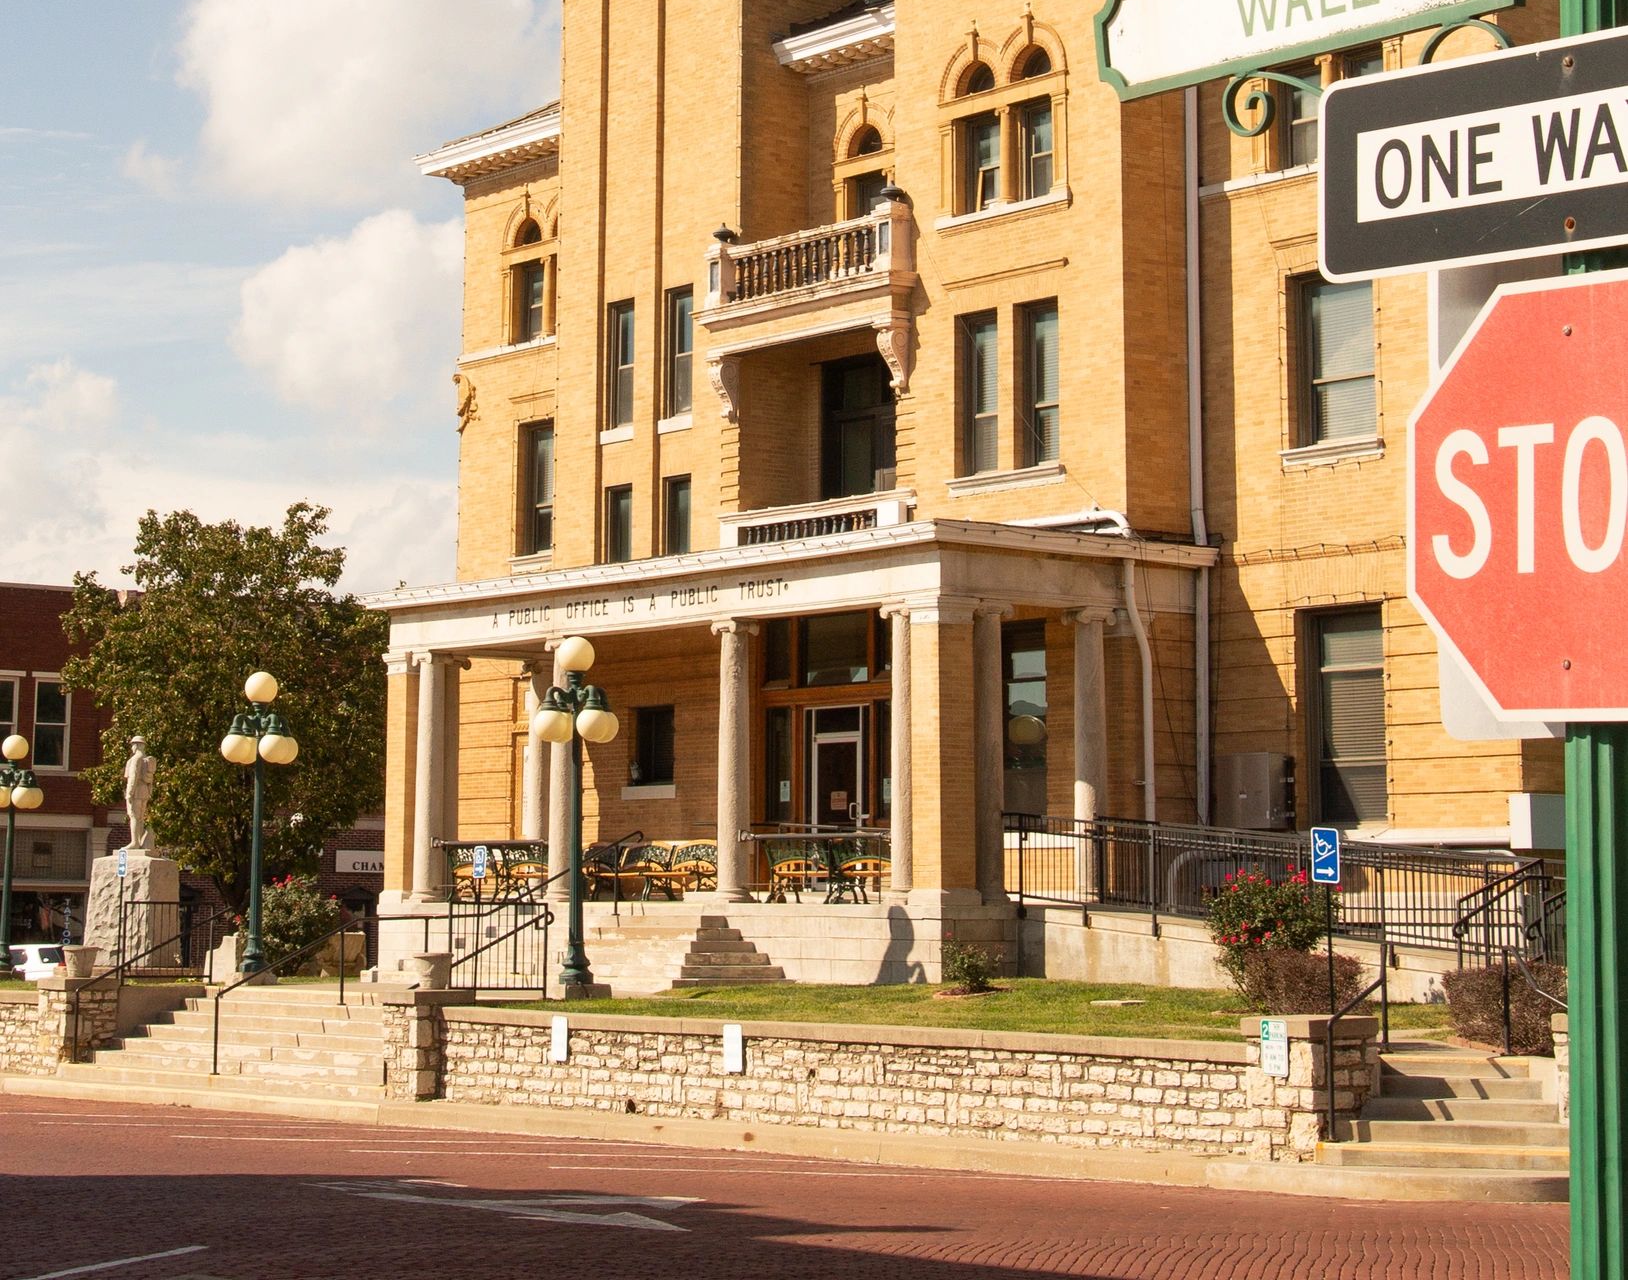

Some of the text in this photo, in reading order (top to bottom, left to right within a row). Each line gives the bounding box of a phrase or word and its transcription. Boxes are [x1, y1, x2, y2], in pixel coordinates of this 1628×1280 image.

[1375, 98, 1628, 210] ONE WA
[1431, 415, 1628, 580] STO
[493, 612, 499, 629] A
[509, 605, 551, 626] PUBLIC
[566, 598, 609, 619] OFFICE
[623, 595, 634, 613] IS
[649, 593, 656, 612] A
[671, 585, 718, 609] PUBLIC
[62, 898, 71, 946] TATTOO
[1262, 1023, 1268, 1038] 2
